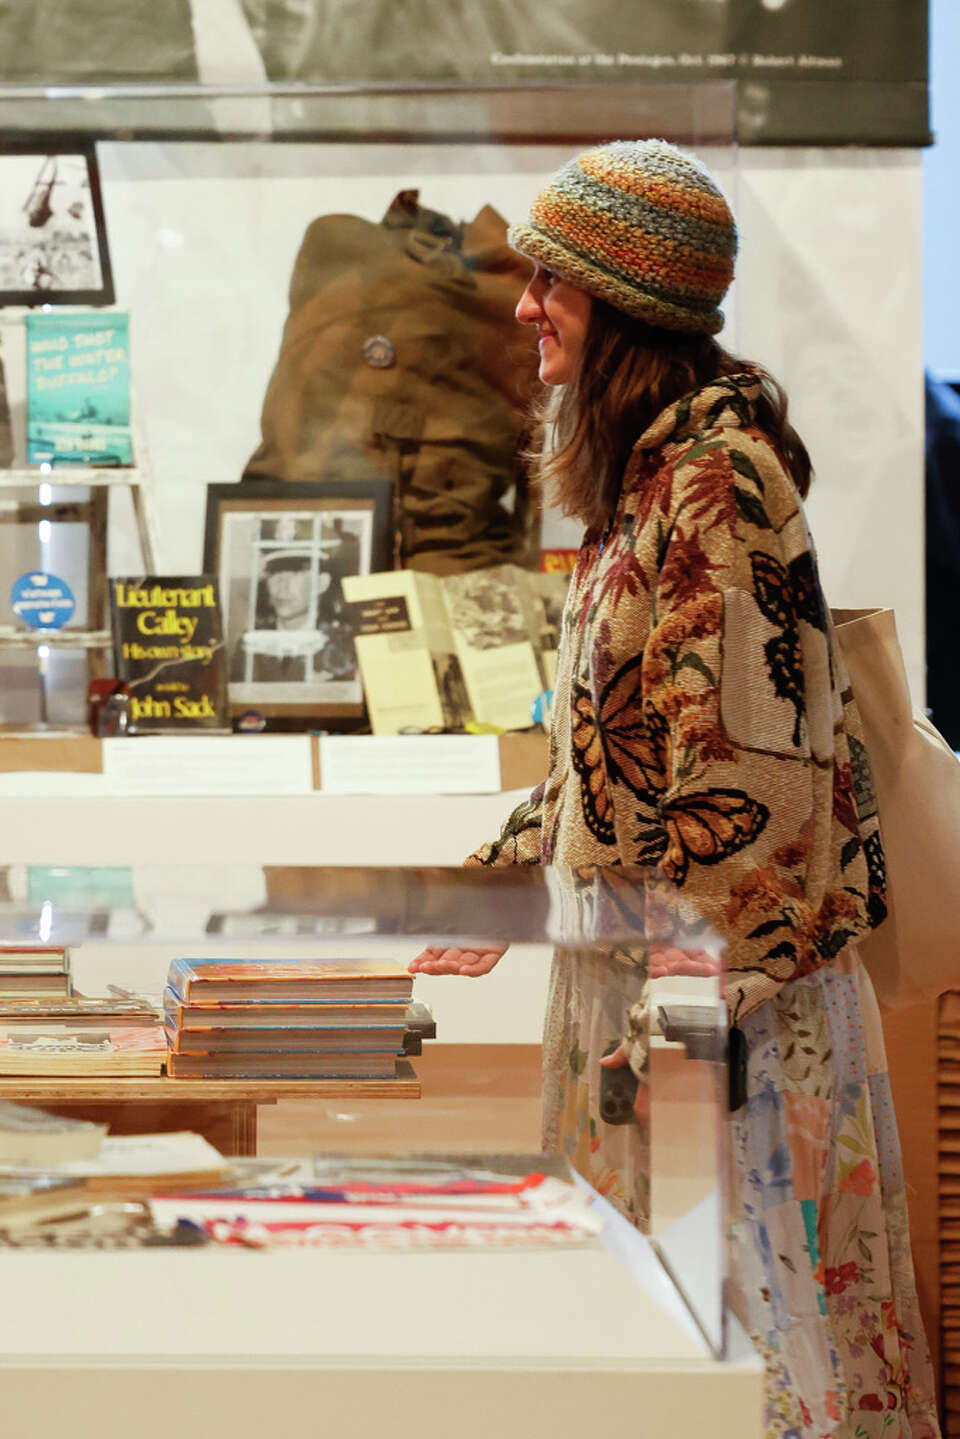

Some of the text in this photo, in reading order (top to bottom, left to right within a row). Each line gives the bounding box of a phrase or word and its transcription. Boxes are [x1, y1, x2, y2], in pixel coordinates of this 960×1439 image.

[33, 347, 127, 372] THE WATER
[116, 583, 216, 608] Lieutenant
[136, 608, 199, 643] Calley
[130, 692, 217, 721] John Sack
